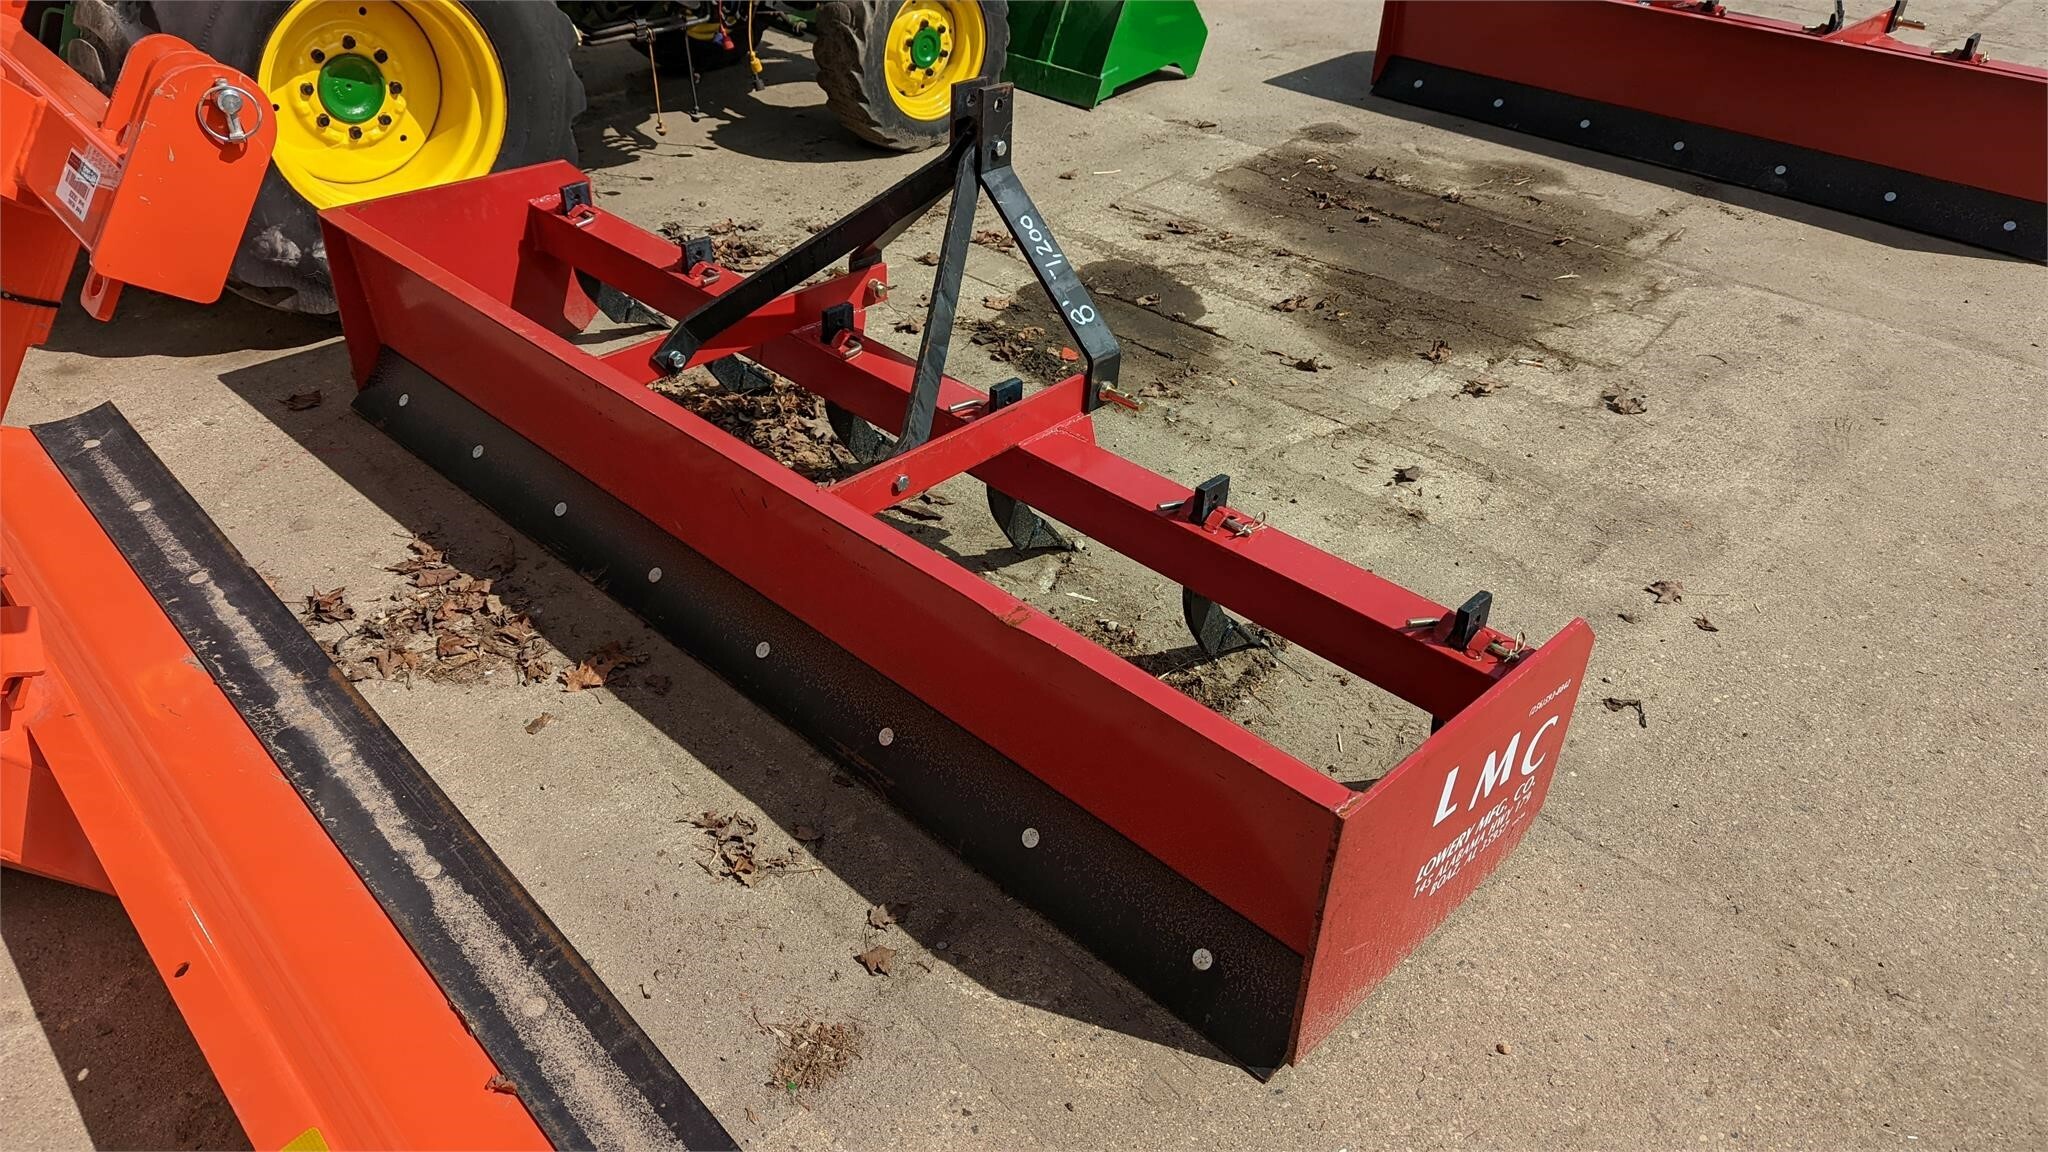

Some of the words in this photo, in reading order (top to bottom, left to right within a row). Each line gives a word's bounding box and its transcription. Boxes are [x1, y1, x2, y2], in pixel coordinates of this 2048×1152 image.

[1415, 823, 1476, 884] LOWERY
[1475, 797, 1508, 835] MFG.
[1514, 775, 1536, 801] CO.
[1435, 830, 1485, 881] ALABAMA
[1488, 806, 1513, 836] HWY
[1464, 847, 1478, 866] AL
